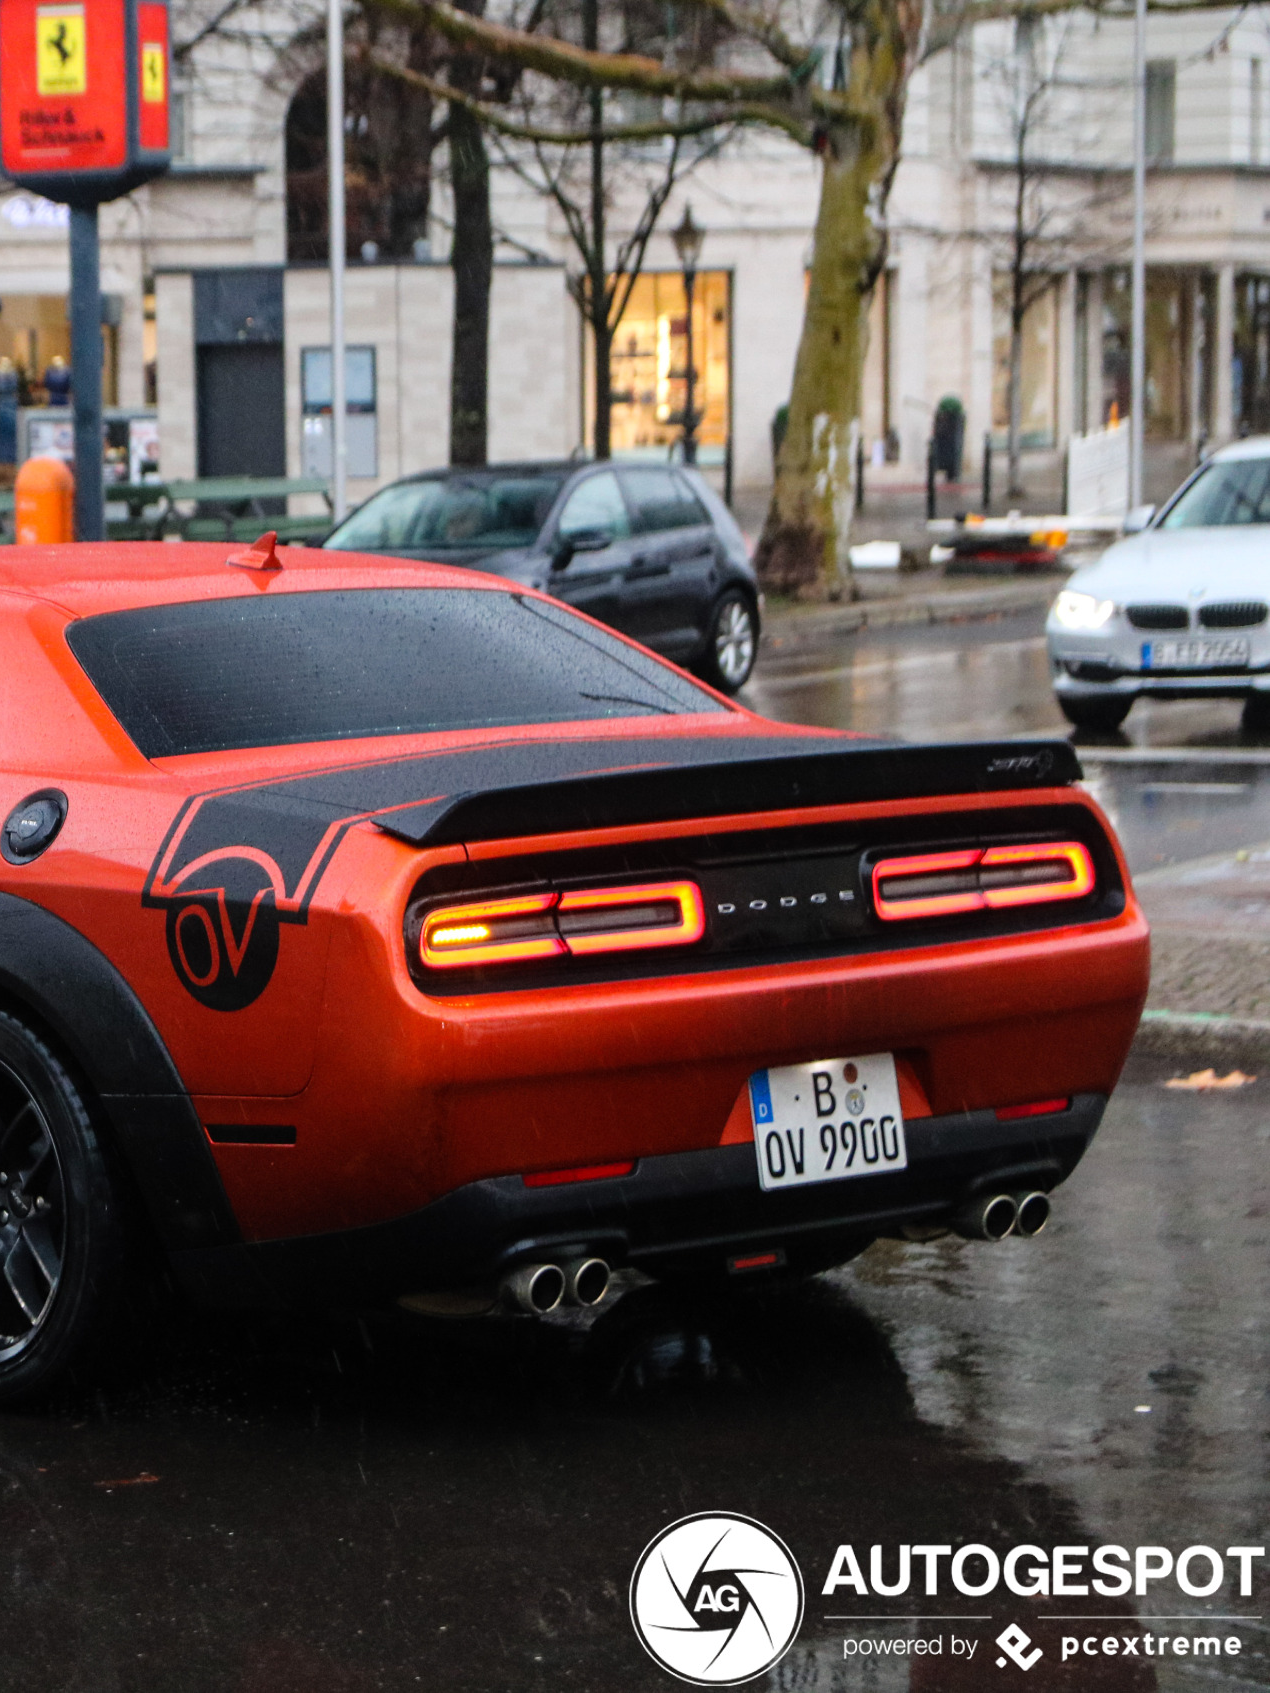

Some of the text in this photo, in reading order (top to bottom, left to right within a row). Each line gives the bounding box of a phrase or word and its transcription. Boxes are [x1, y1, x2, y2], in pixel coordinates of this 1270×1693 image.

[717, 889, 855, 914] DODGE
[758, 1071, 837, 1118] D B
[765, 1115, 900, 1179] OV 9900
